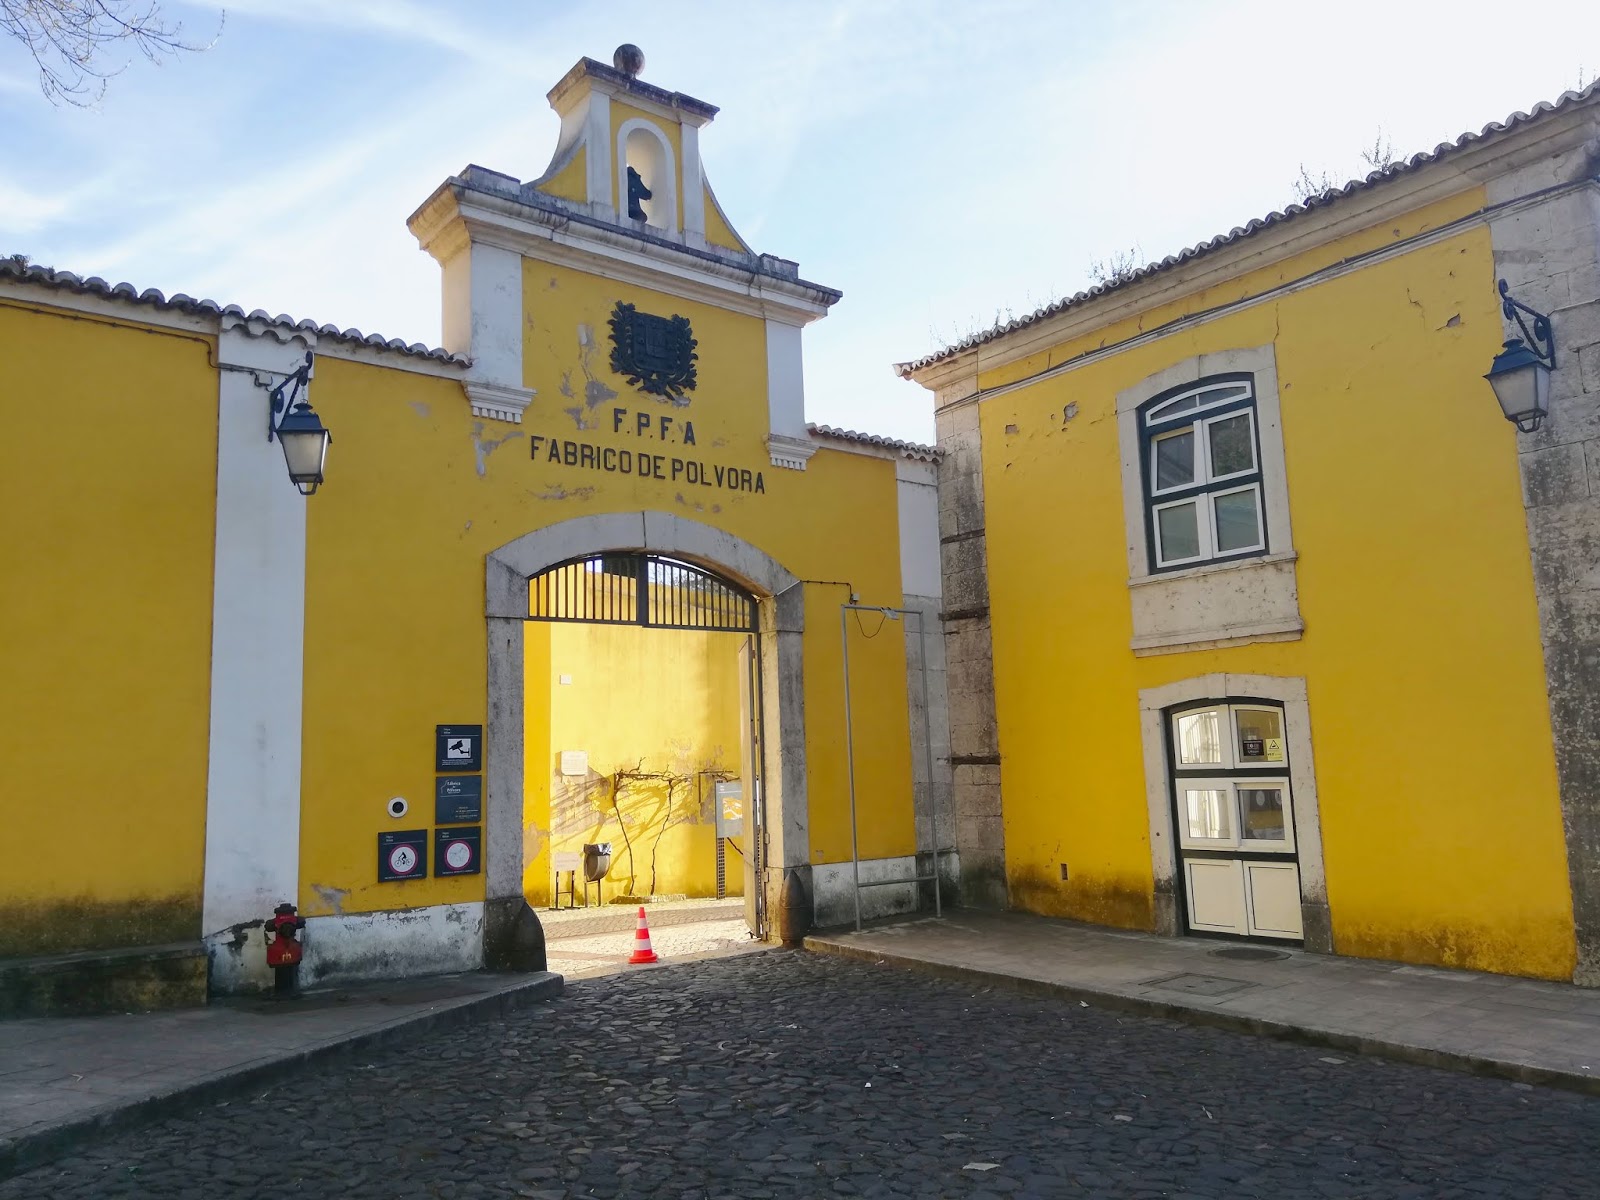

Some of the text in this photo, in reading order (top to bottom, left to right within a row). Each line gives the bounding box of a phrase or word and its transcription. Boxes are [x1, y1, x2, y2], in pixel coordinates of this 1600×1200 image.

[530, 435, 765, 495] FABRICO DE POLVORA
